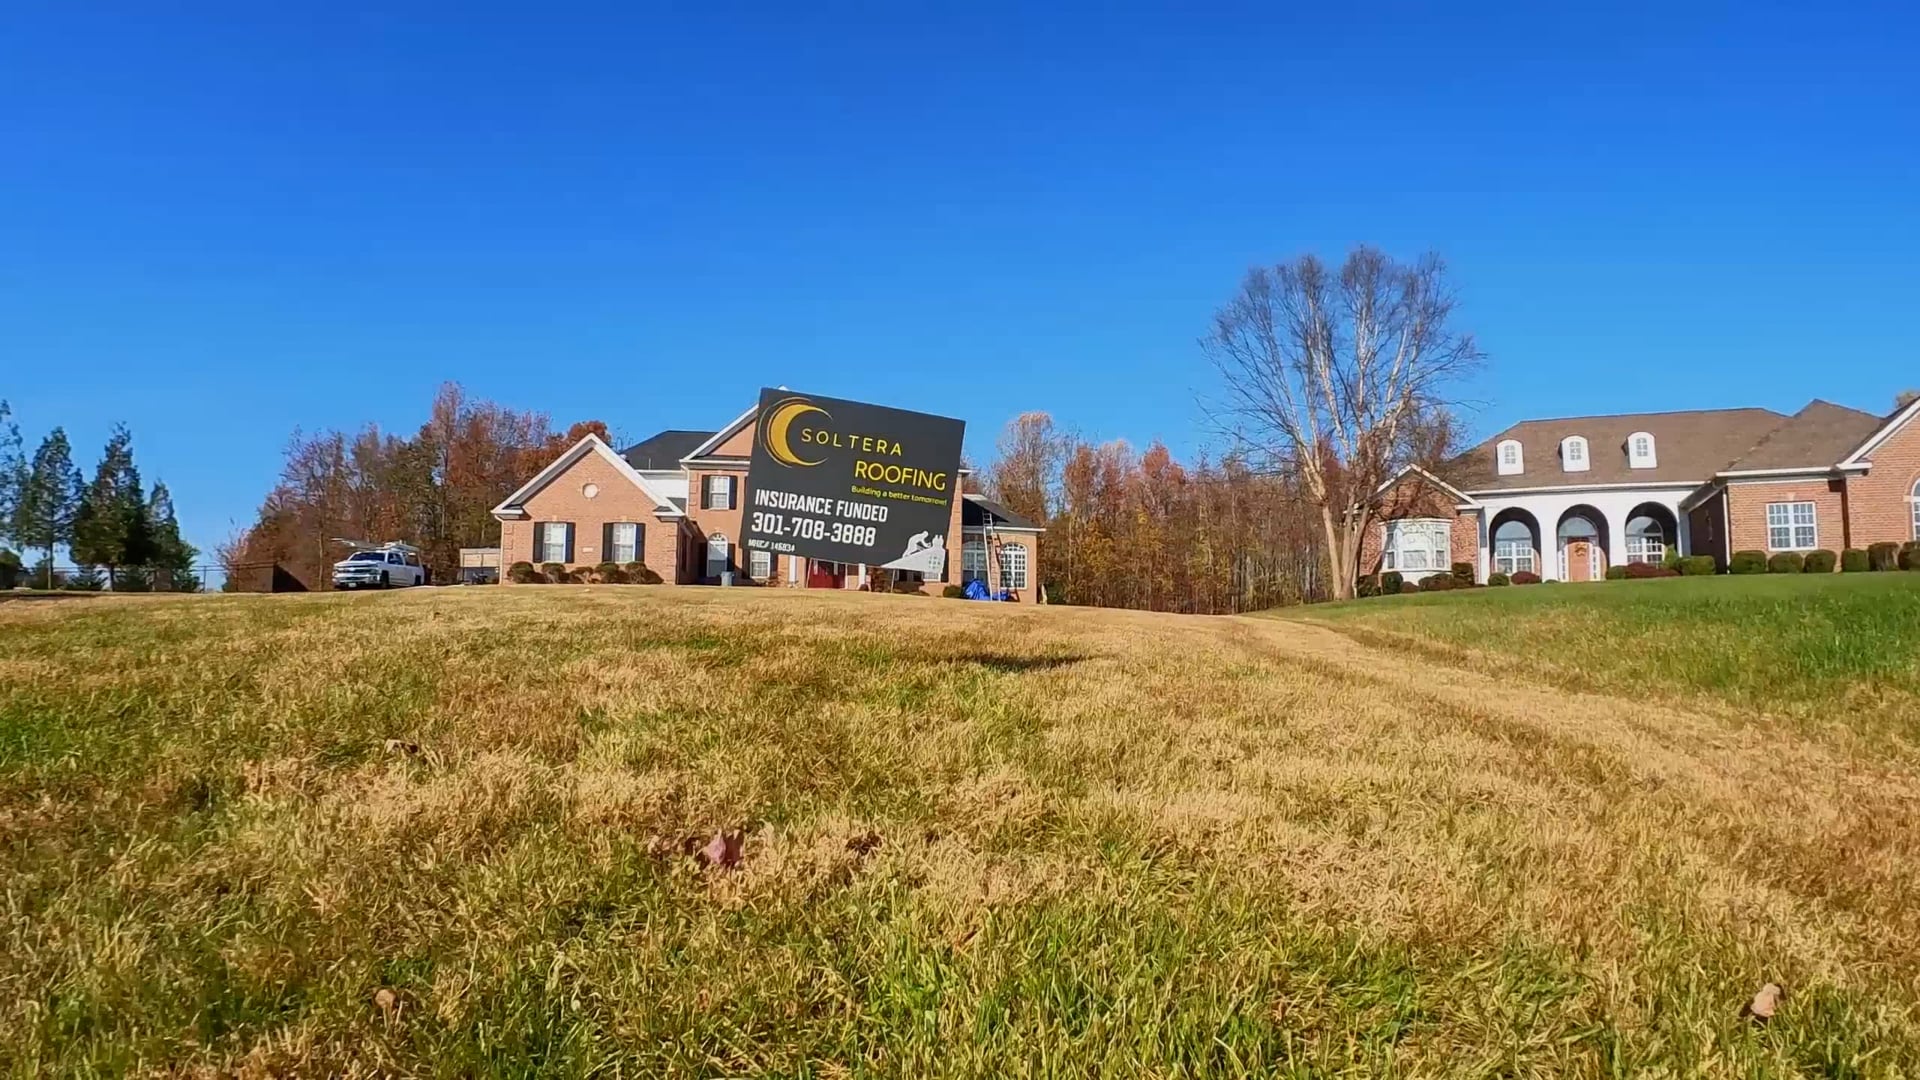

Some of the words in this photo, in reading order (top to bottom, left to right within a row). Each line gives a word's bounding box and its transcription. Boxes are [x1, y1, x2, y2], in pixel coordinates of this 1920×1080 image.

[801, 427, 902, 456] SOLTERA
[854, 461, 946, 490] ROOFING
[755, 489, 833, 515] INSURANCE
[836, 500, 888, 523] FUNDED
[851, 485, 881, 498] Building
[888, 491, 910, 500] better
[751, 512, 876, 547] 301-708-3888
